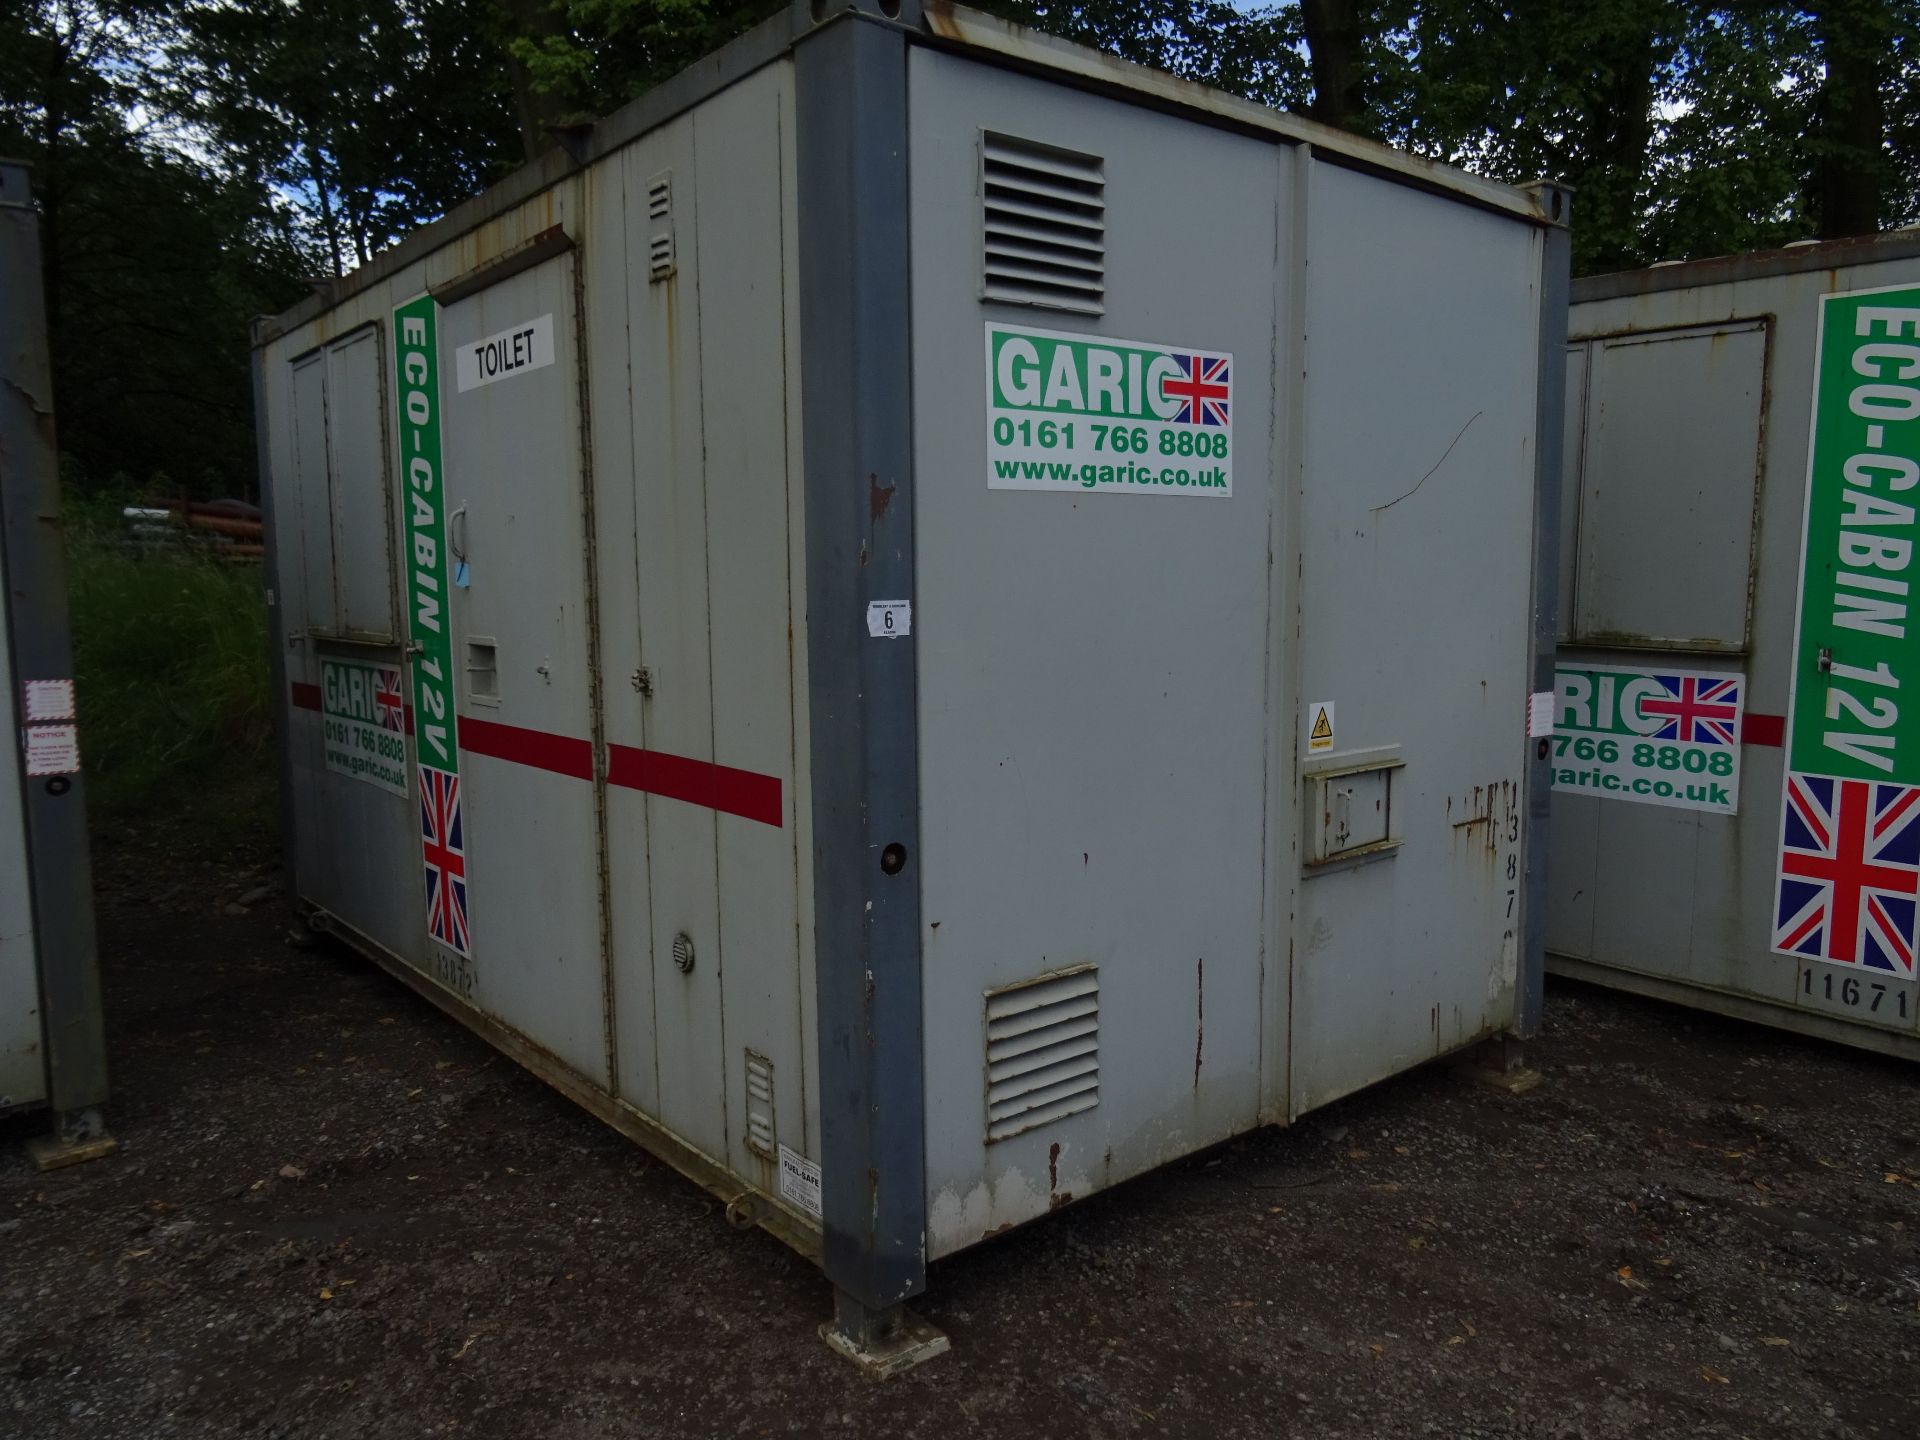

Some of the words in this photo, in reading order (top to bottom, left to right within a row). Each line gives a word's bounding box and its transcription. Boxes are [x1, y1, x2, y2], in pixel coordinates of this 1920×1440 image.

[475, 328, 535, 379] TOILET
[997, 336, 1184, 420] GARIC
[993, 416, 1075, 450] 0161
[1090, 424, 1149, 454] 766
[1158, 429, 1228, 459] 8808
[402, 316, 441, 634] ECO-CABIN
[994, 460, 1228, 488] www.garic.co.uk
[1831, 305, 1920, 640] ECO-CABIN
[884, 610, 894, 630] 6
[322, 663, 386, 726] GARIC
[420, 655, 449, 763] 12V
[1822, 661, 1901, 774] 12V
[325, 719, 350, 746] 0161
[353, 726, 376, 754] 766
[378, 732, 405, 764] 8808
[1551, 734, 1619, 764] 766
[1632, 743, 1734, 777] 8808
[327, 751, 407, 788] www.garic.co.uk
[1803, 968, 1907, 1018] 11671
